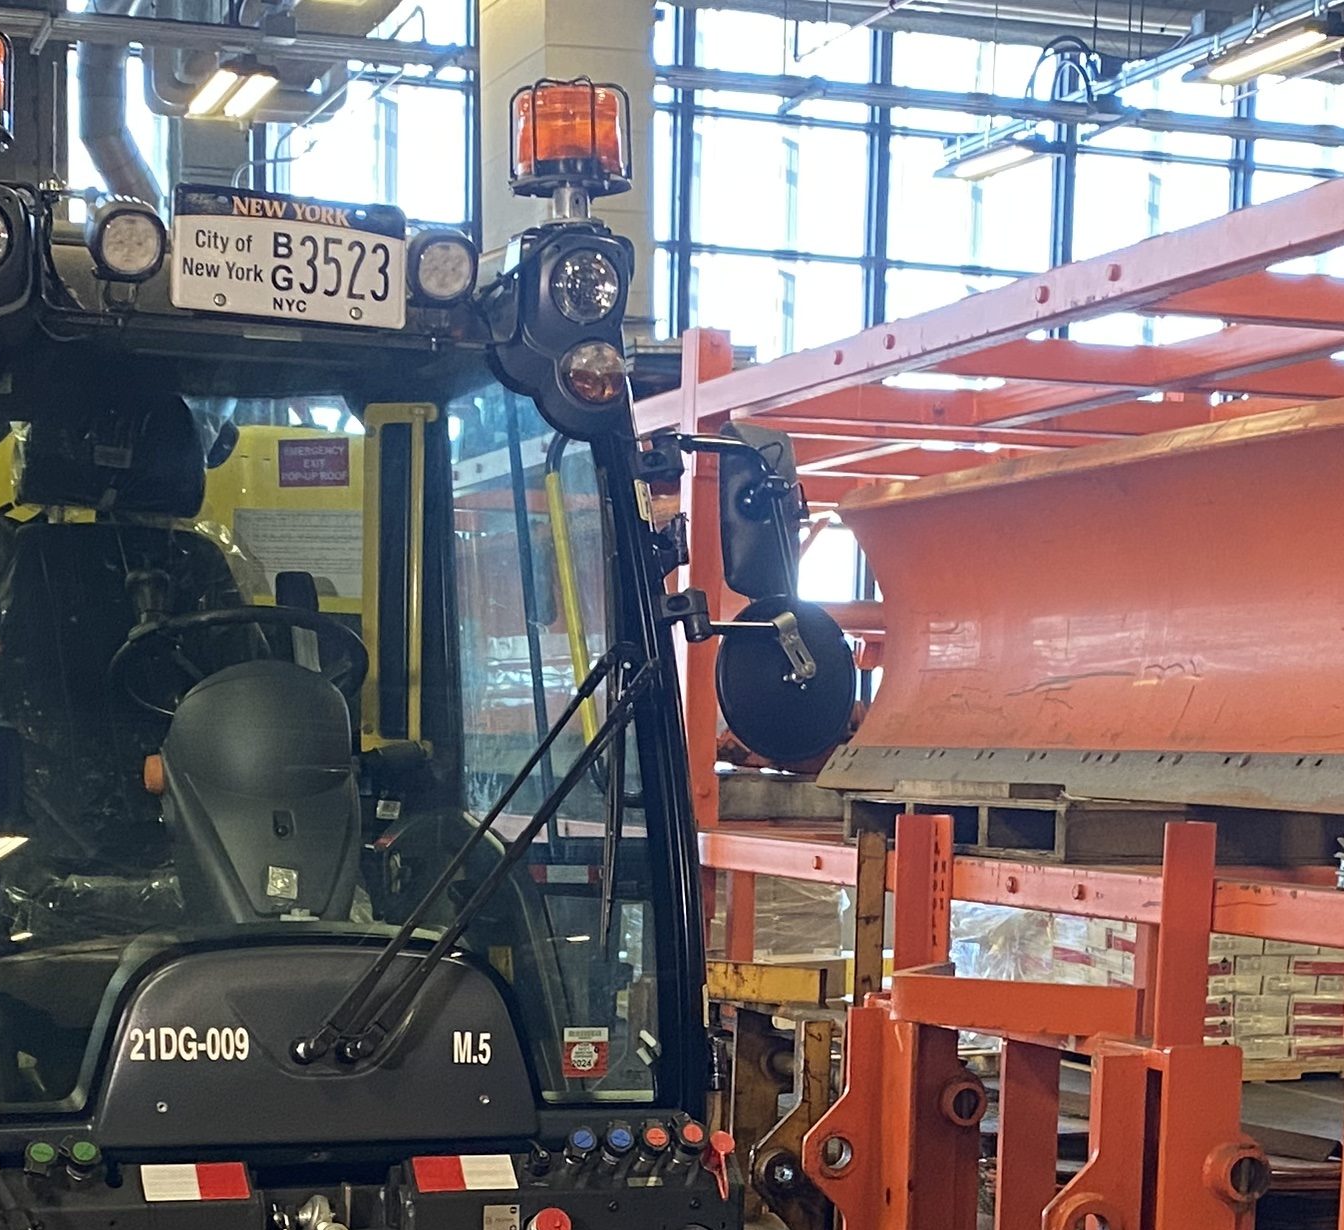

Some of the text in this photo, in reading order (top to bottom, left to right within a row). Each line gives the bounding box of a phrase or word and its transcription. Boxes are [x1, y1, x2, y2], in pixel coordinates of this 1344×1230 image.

[232, 195, 351, 227] NEW YORK
[195, 229, 253, 253] City of
[182, 257, 264, 283] New York
[298, 234, 391, 302] 3523
[272, 297, 307, 313] NYC
[283, 445, 345, 457] EMERGENCY
[303, 457, 325, 468] EXIT
[130, 1026, 249, 1062] 21DG-009
[453, 1030, 492, 1065] M.5
